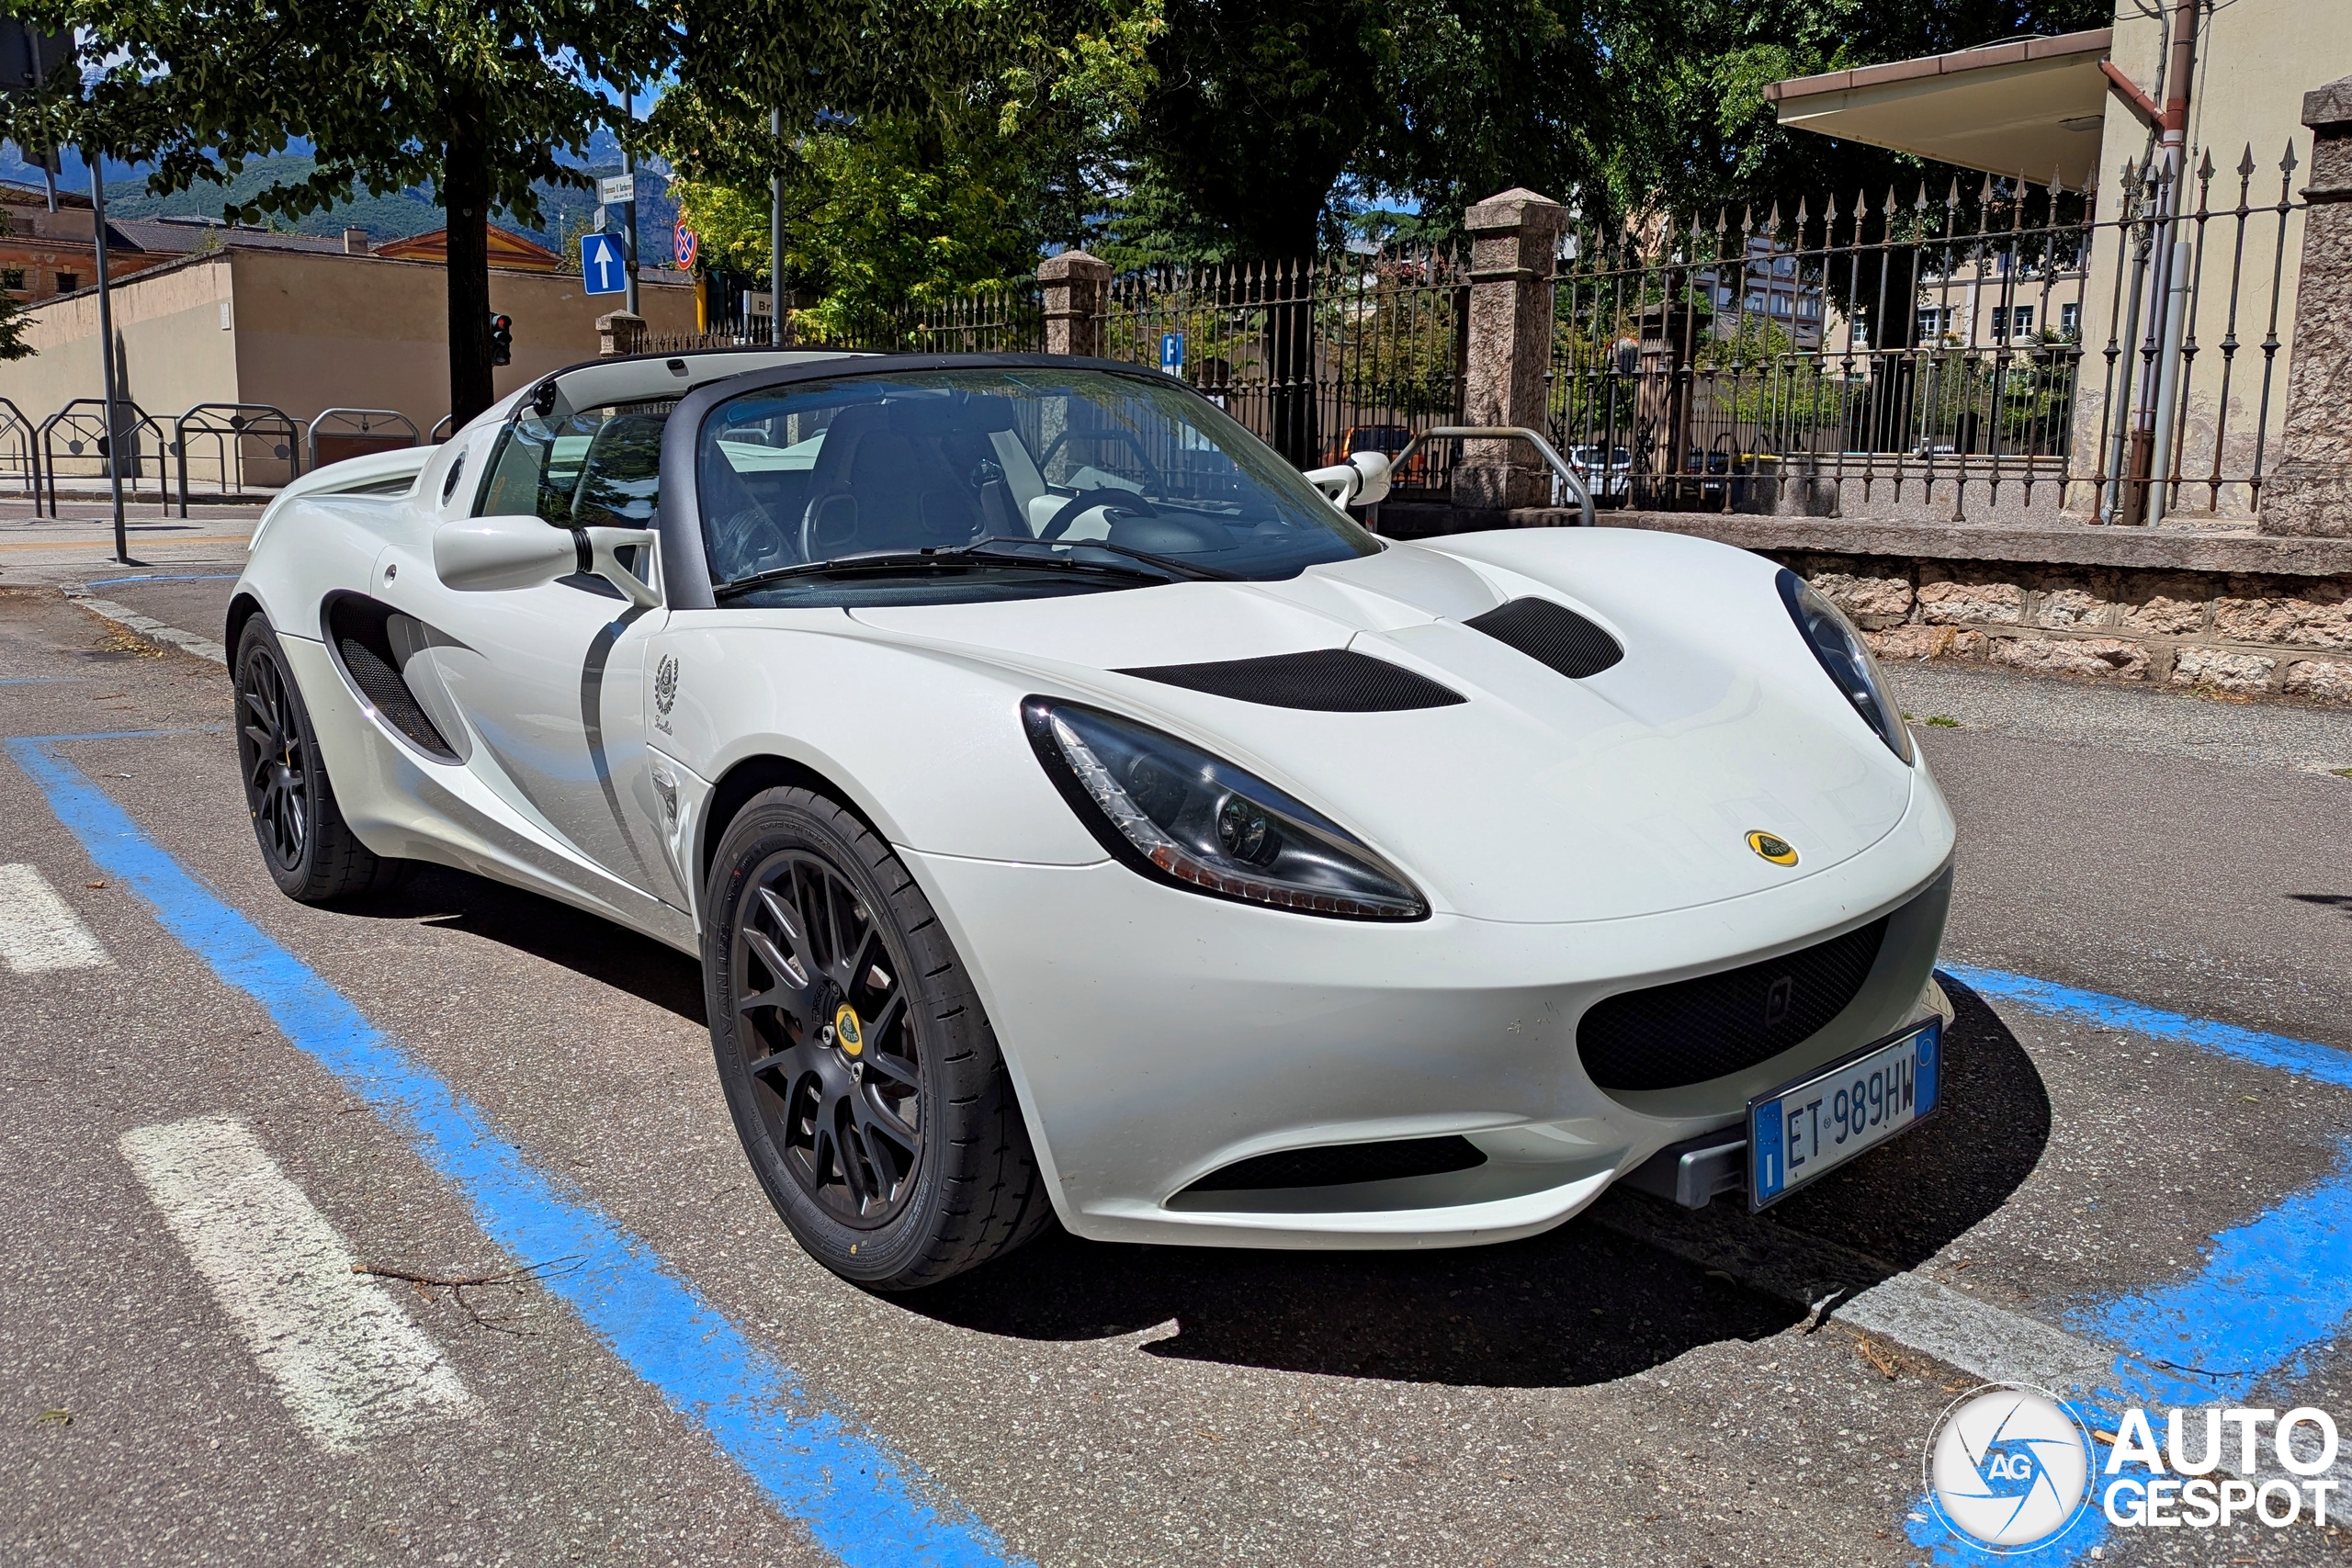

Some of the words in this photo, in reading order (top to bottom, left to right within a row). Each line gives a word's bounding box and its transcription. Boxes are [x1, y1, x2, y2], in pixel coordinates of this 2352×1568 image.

[759, 301, 773, 311] Br
[812, 985, 826, 1025] FORGED
[718, 973, 743, 1077] ADVAN
[840, 1025, 859, 1042] LOTUS
[1787, 1098, 1823, 1170] ET
[1834, 1055, 1915, 1145] 989HW
[1766, 1153, 1773, 1189] I
